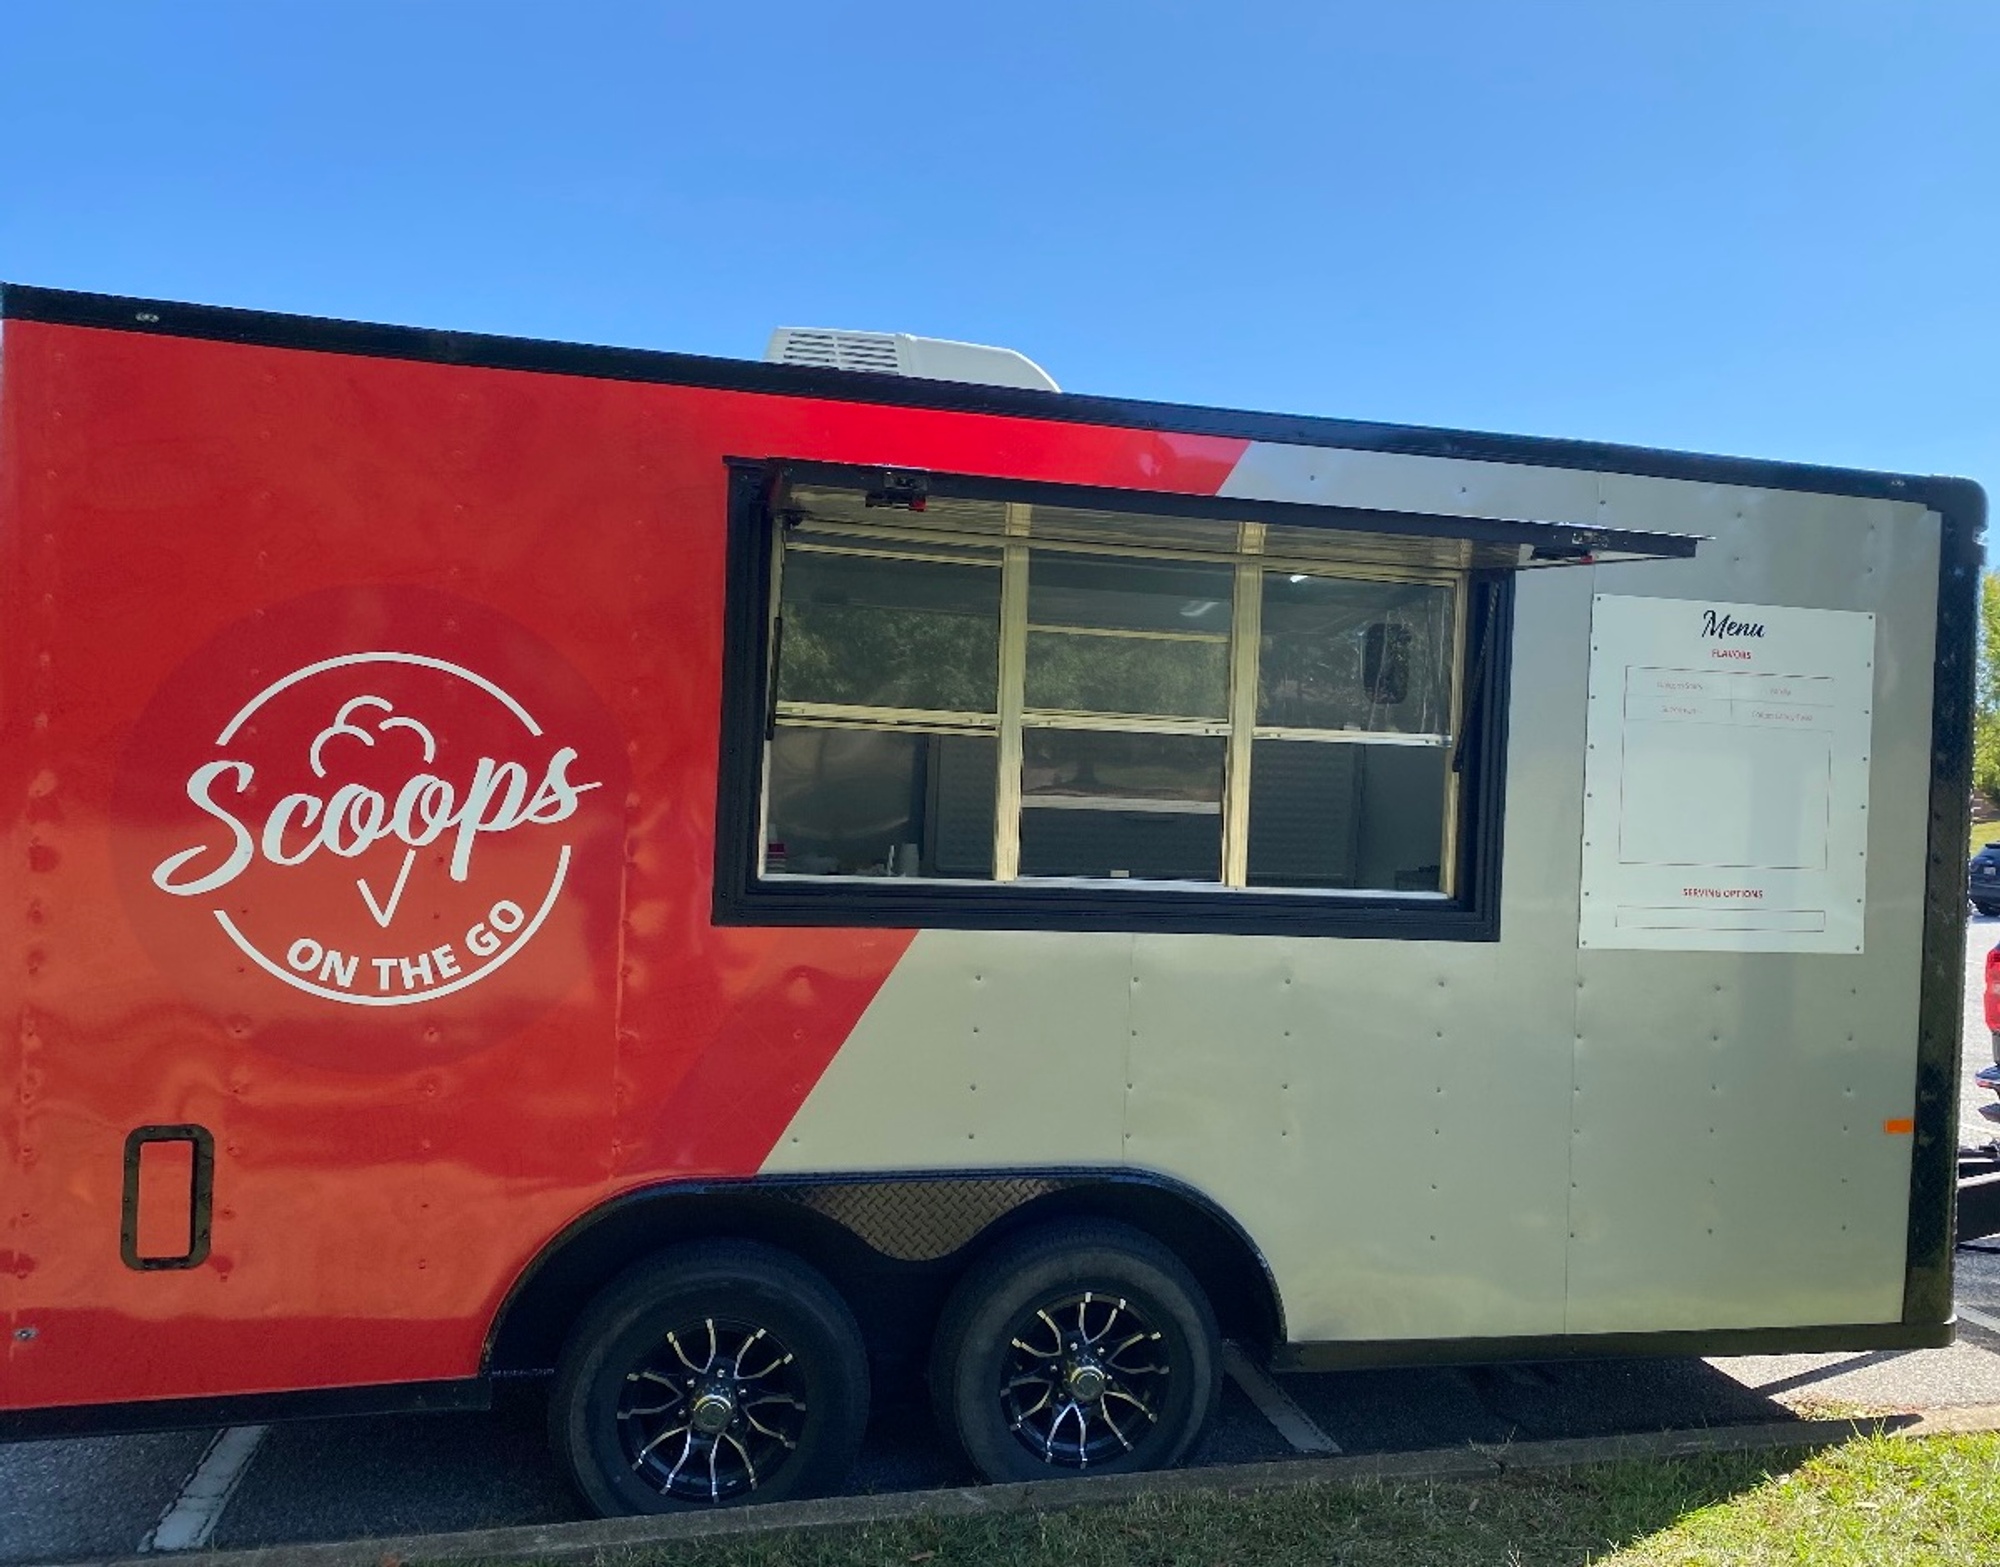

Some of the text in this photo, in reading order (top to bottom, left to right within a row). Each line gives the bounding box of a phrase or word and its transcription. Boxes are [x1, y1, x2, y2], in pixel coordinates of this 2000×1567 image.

[1701, 609, 1766, 639] Menu
[1711, 648, 1752, 660] FLAVORS
[151, 747, 603, 896] Scoops
[1682, 888, 1763, 900] SERVING OPTIONS
[287, 900, 525, 991] ON THE GO
